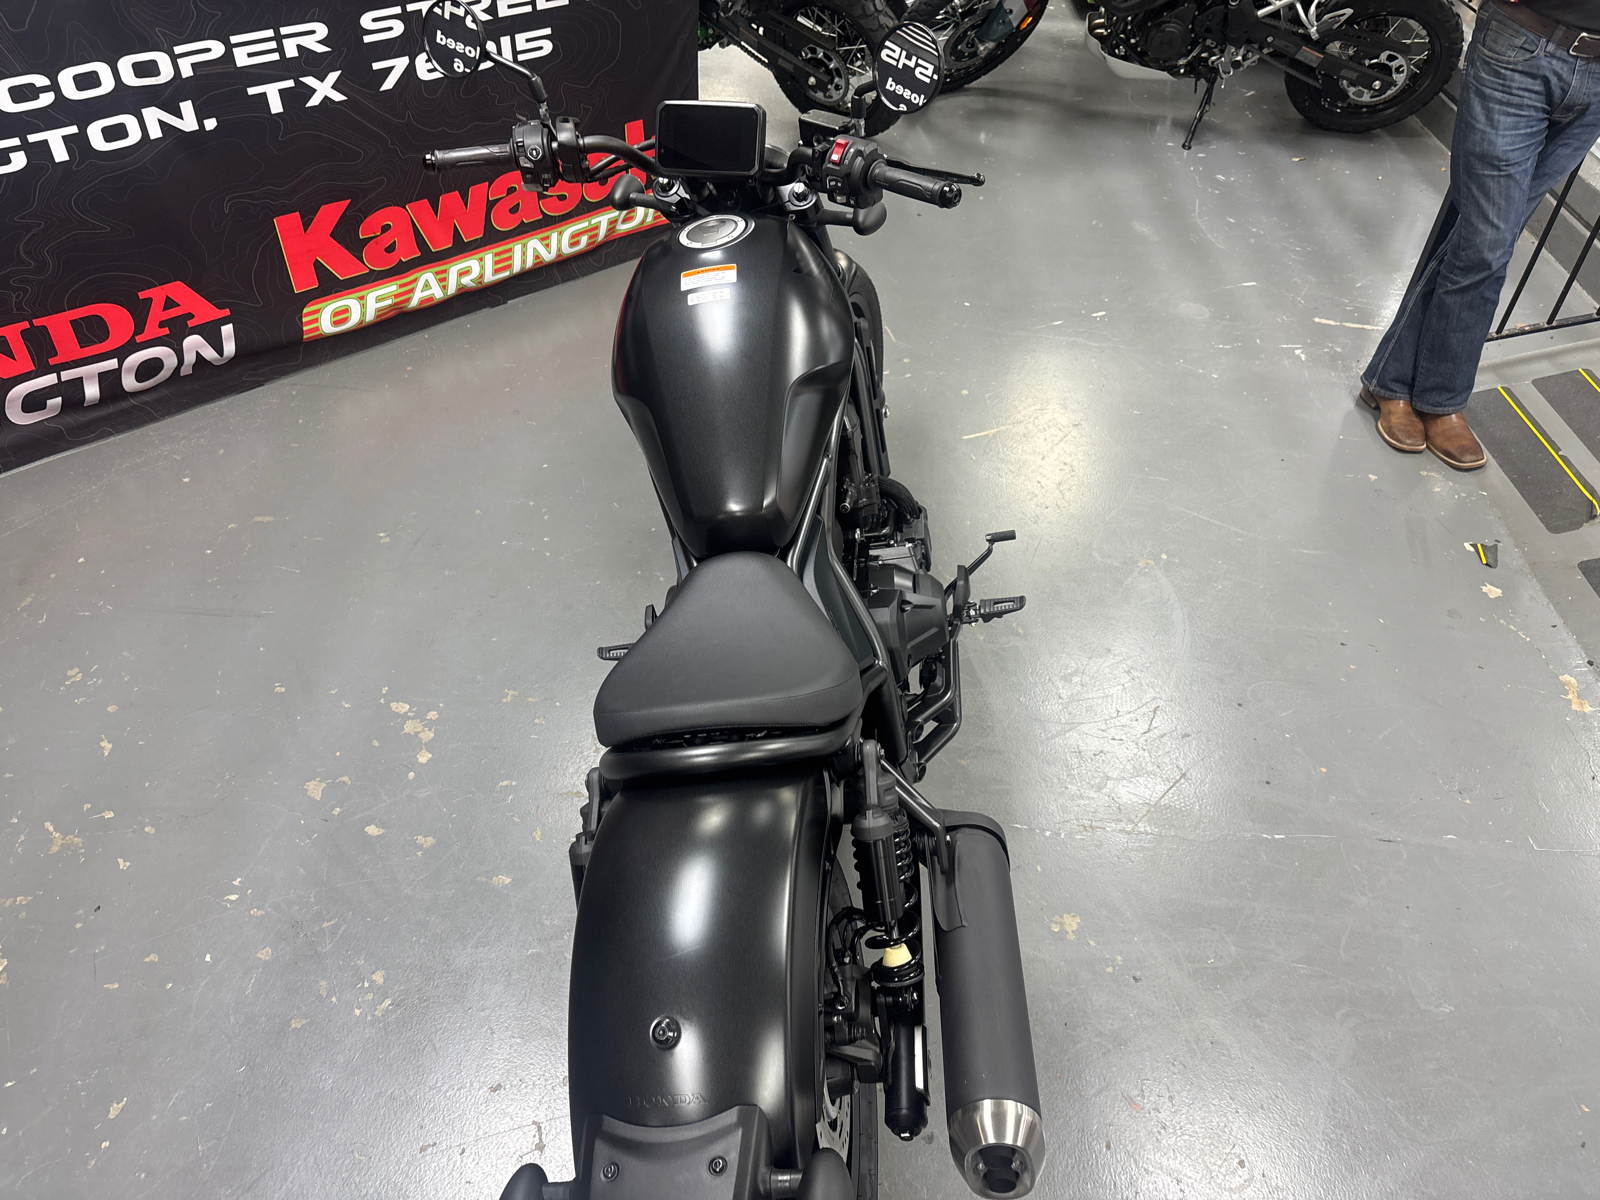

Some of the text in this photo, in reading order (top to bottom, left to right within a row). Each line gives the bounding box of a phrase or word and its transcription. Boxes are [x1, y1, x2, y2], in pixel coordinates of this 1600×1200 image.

[0, 22, 333, 113] COOPER
[246, 70, 349, 115] TX
[320, 284, 398, 335] OF
